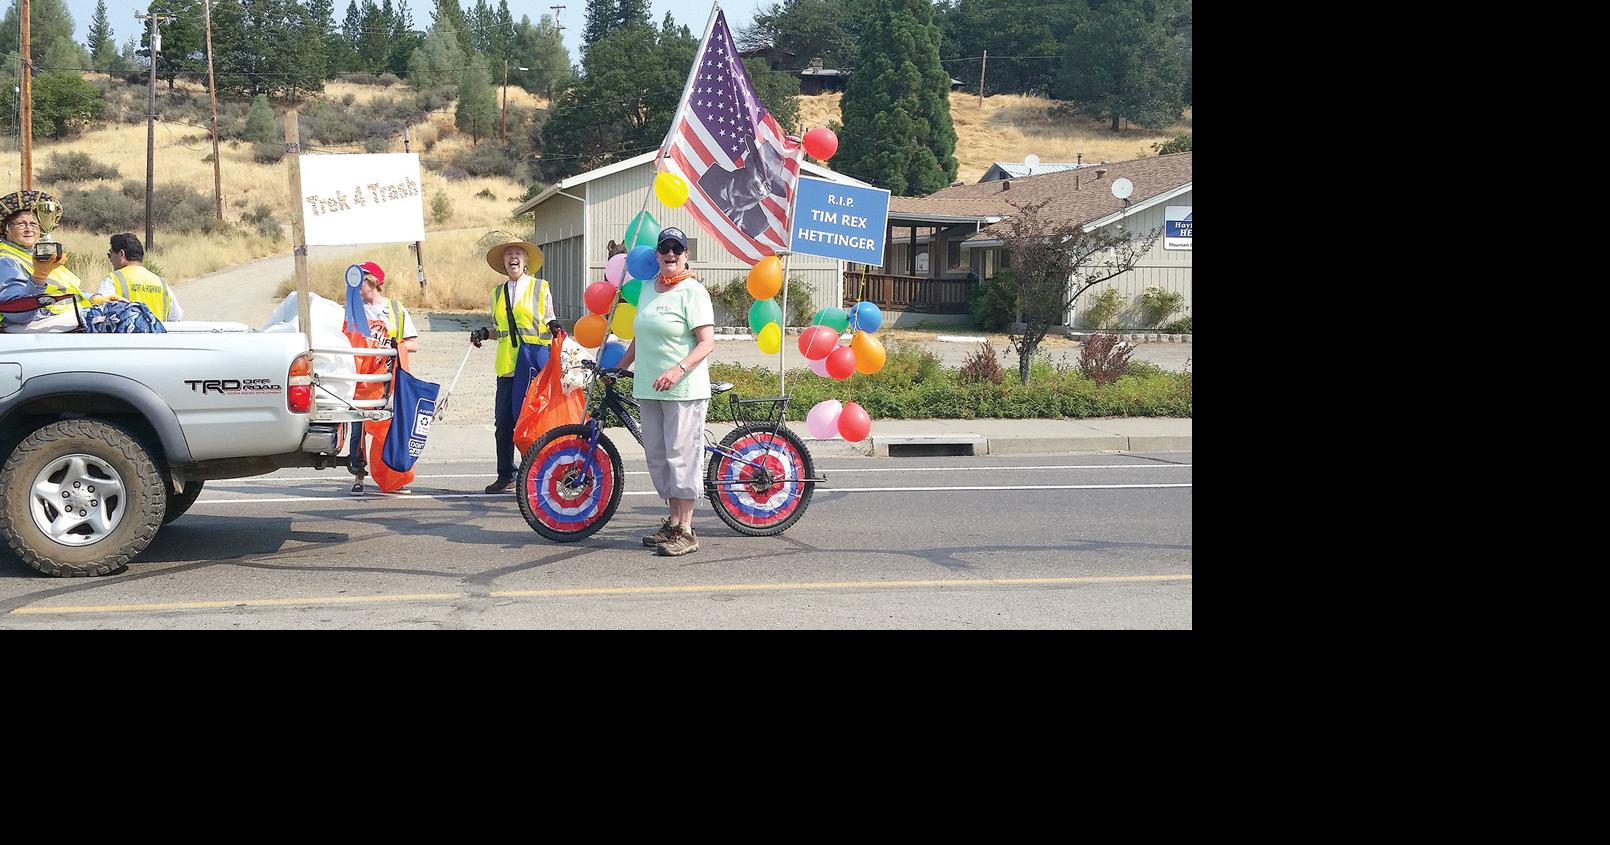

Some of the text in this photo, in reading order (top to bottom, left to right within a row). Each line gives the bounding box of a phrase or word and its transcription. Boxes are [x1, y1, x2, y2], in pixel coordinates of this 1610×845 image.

[306, 176, 418, 216] Trek 4 Trash
[828, 194, 854, 207] R.I.P.
[811, 209, 868, 229] TIM REX
[798, 227, 875, 251] HETTINGER
[184, 379, 241, 394] TRD
